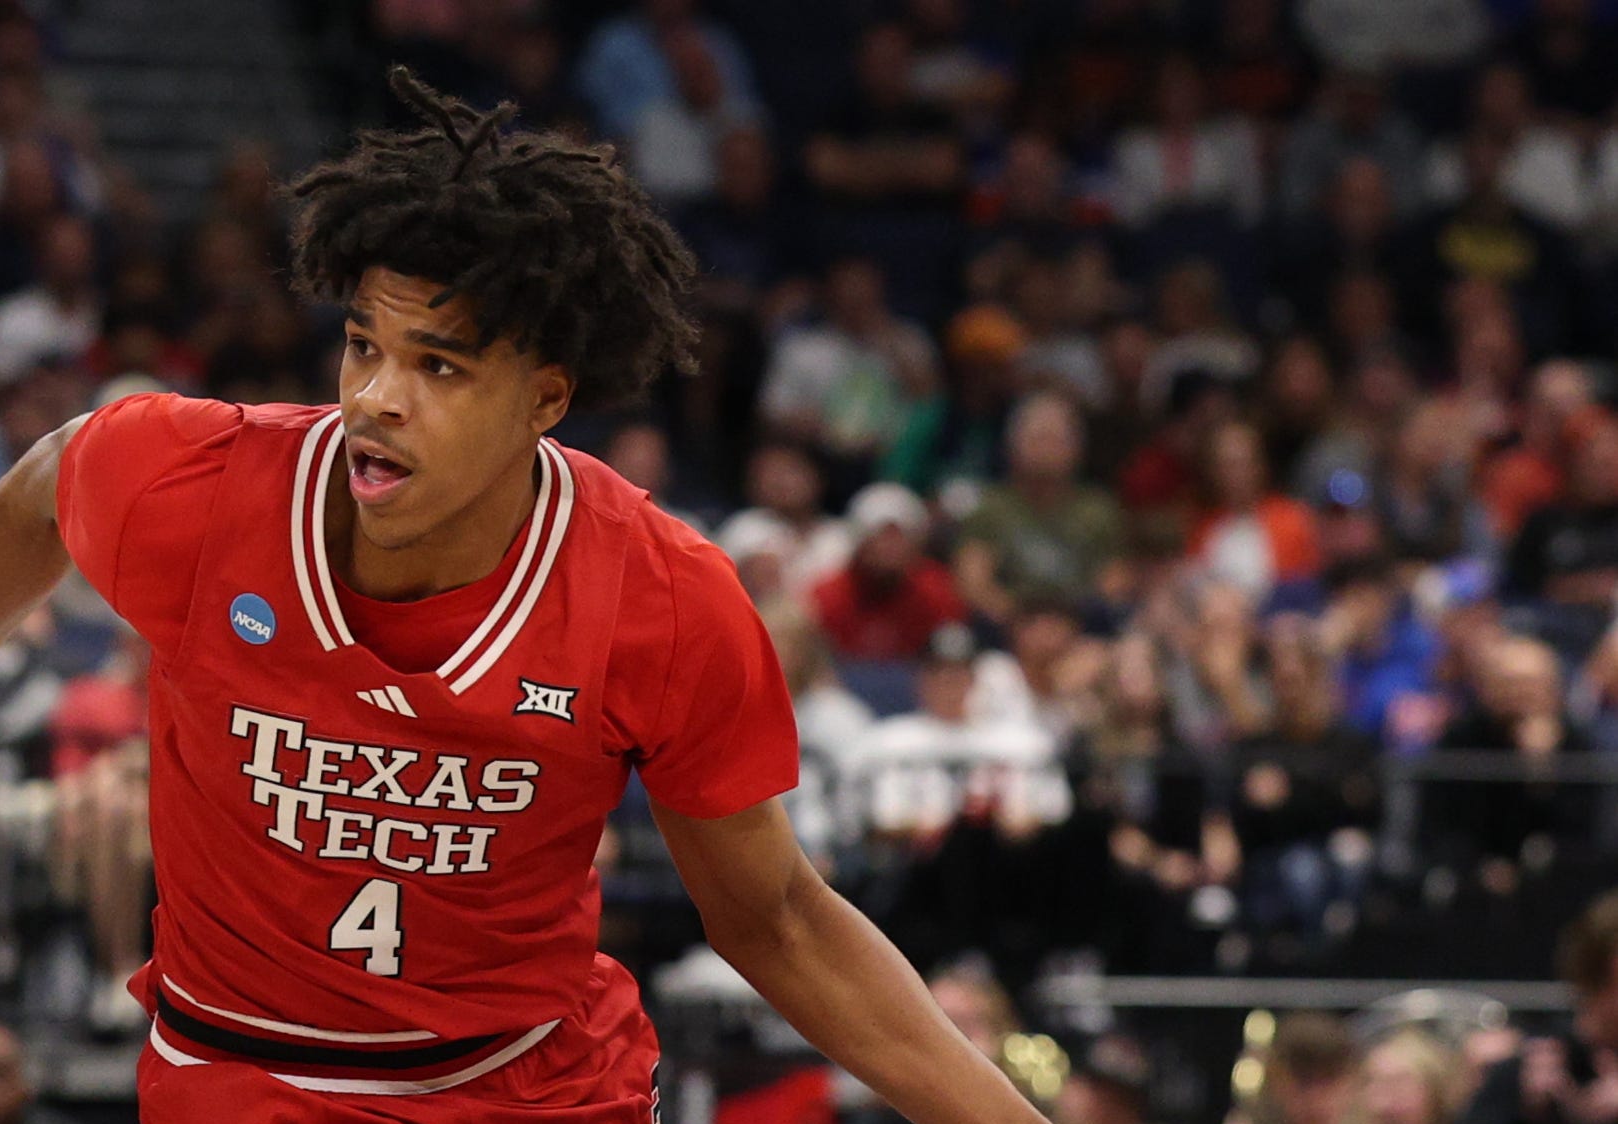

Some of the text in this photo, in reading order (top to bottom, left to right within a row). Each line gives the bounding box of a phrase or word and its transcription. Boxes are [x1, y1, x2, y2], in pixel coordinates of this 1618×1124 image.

[233, 610, 272, 640] NCAA
[515, 679, 579, 722] XII
[230, 705, 541, 813] TEXAS
[253, 779, 498, 875] TECH
[329, 876, 403, 978] 4
